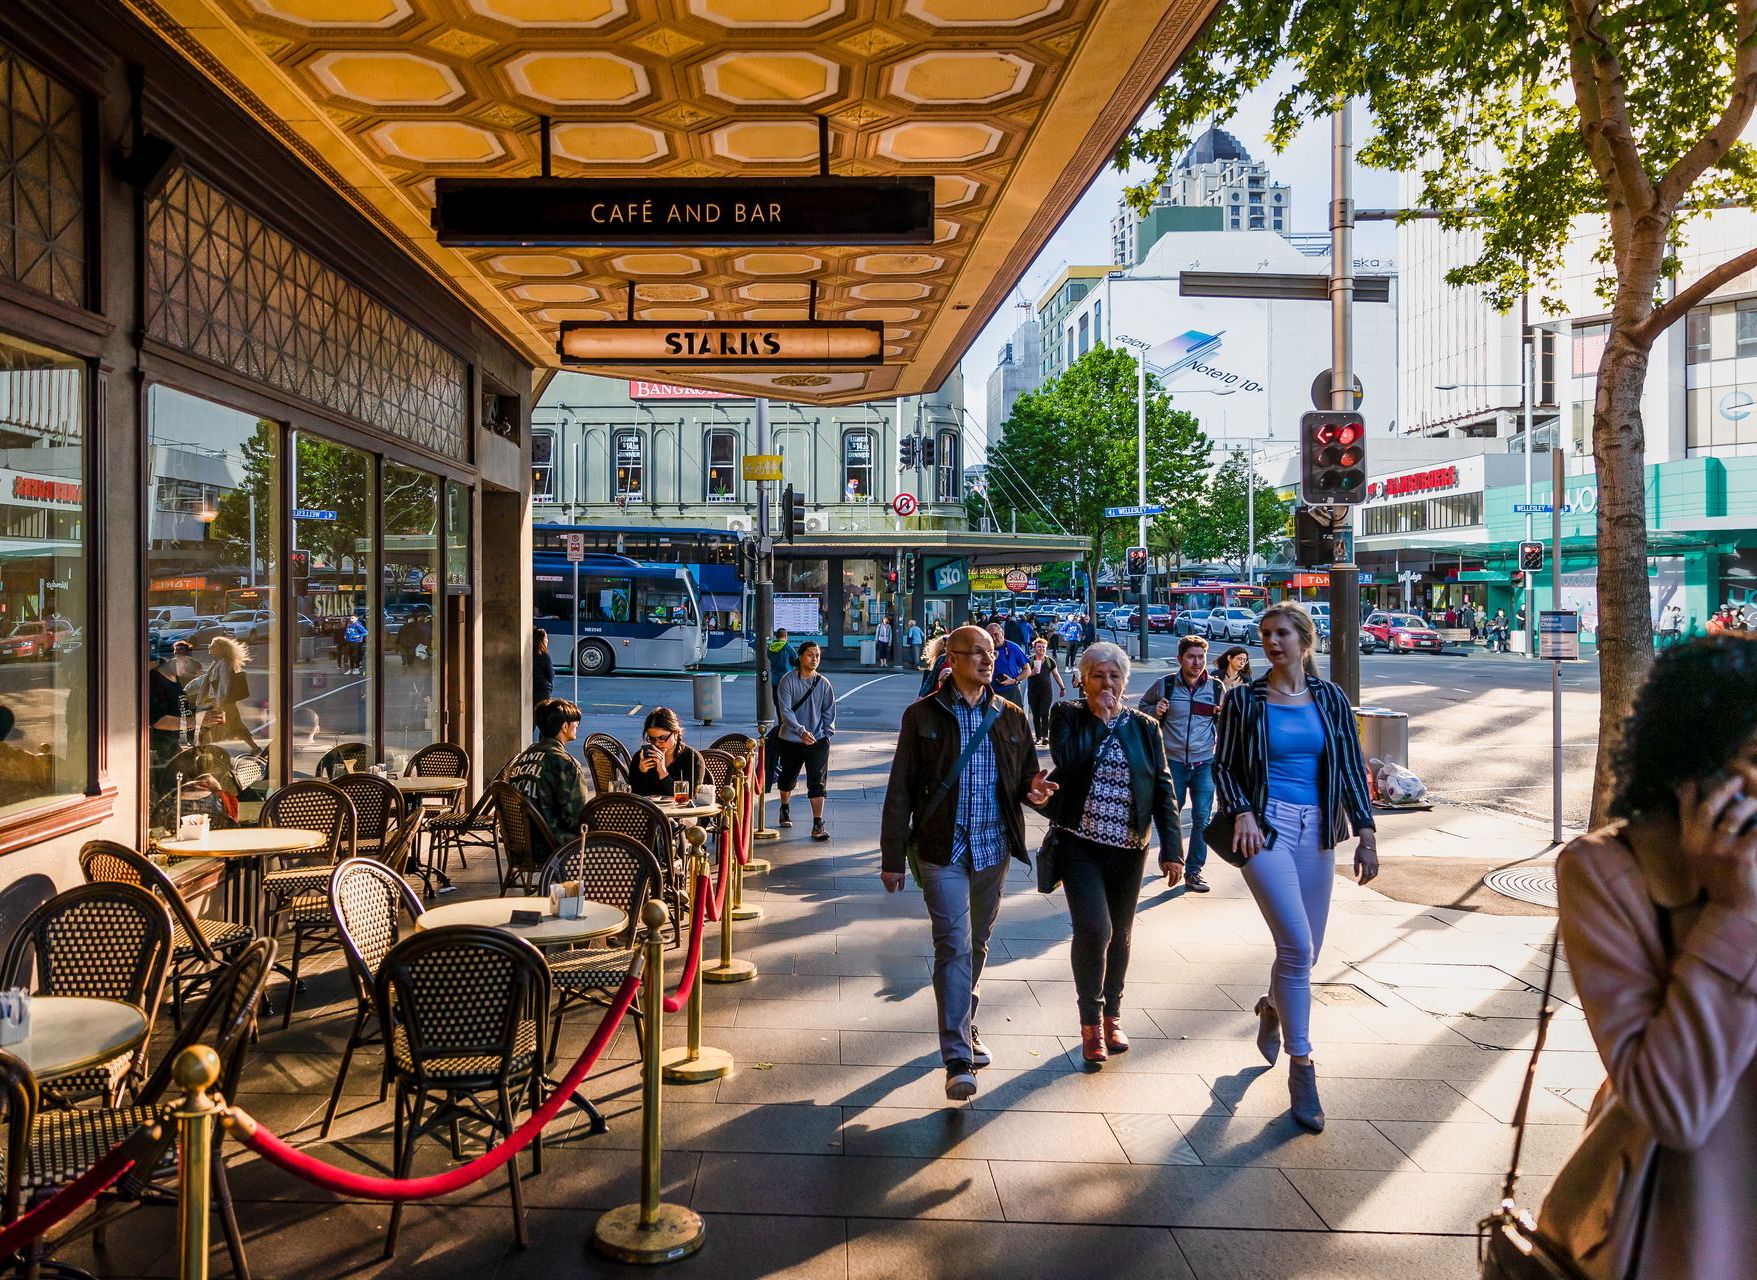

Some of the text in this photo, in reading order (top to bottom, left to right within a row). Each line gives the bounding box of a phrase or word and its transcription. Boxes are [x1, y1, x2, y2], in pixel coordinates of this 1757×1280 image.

[591, 200, 781, 223] CAFÉ AND BAR
[664, 331, 781, 355] STARK'S
[1115, 334, 1151, 351] Galaxy
[1119, 507, 1147, 515] WELLESLEY
[1516, 504, 1546, 512] WELLESLEY
[519, 752, 546, 762] ANTI
[510, 764, 543, 778] SOCIAL
